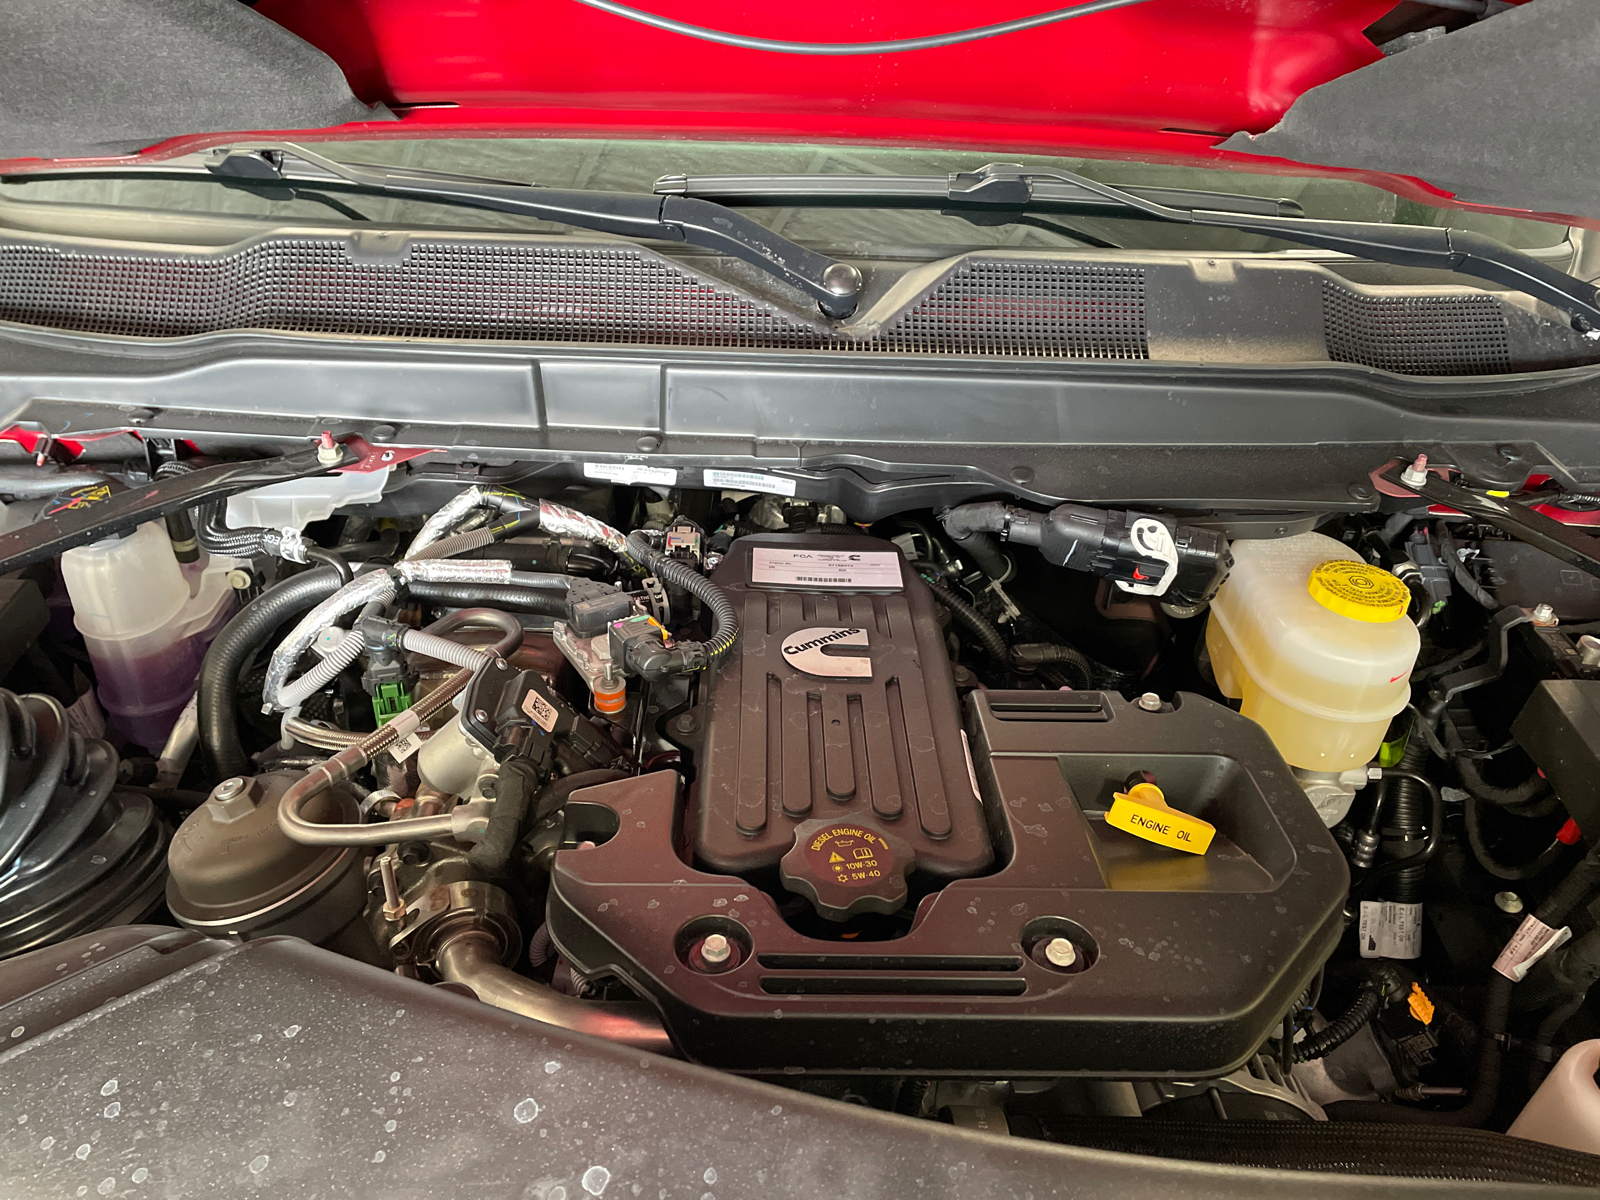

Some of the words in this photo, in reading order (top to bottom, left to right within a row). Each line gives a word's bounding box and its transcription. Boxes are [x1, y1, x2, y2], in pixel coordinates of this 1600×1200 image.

[783, 628, 861, 655] Cummins
[811, 832, 834, 851] DIESEL
[832, 828, 864, 838] ENGINE
[863, 833, 877, 844] OIL
[1130, 814, 1171, 835] ENGINE
[1176, 830, 1192, 842] OIL
